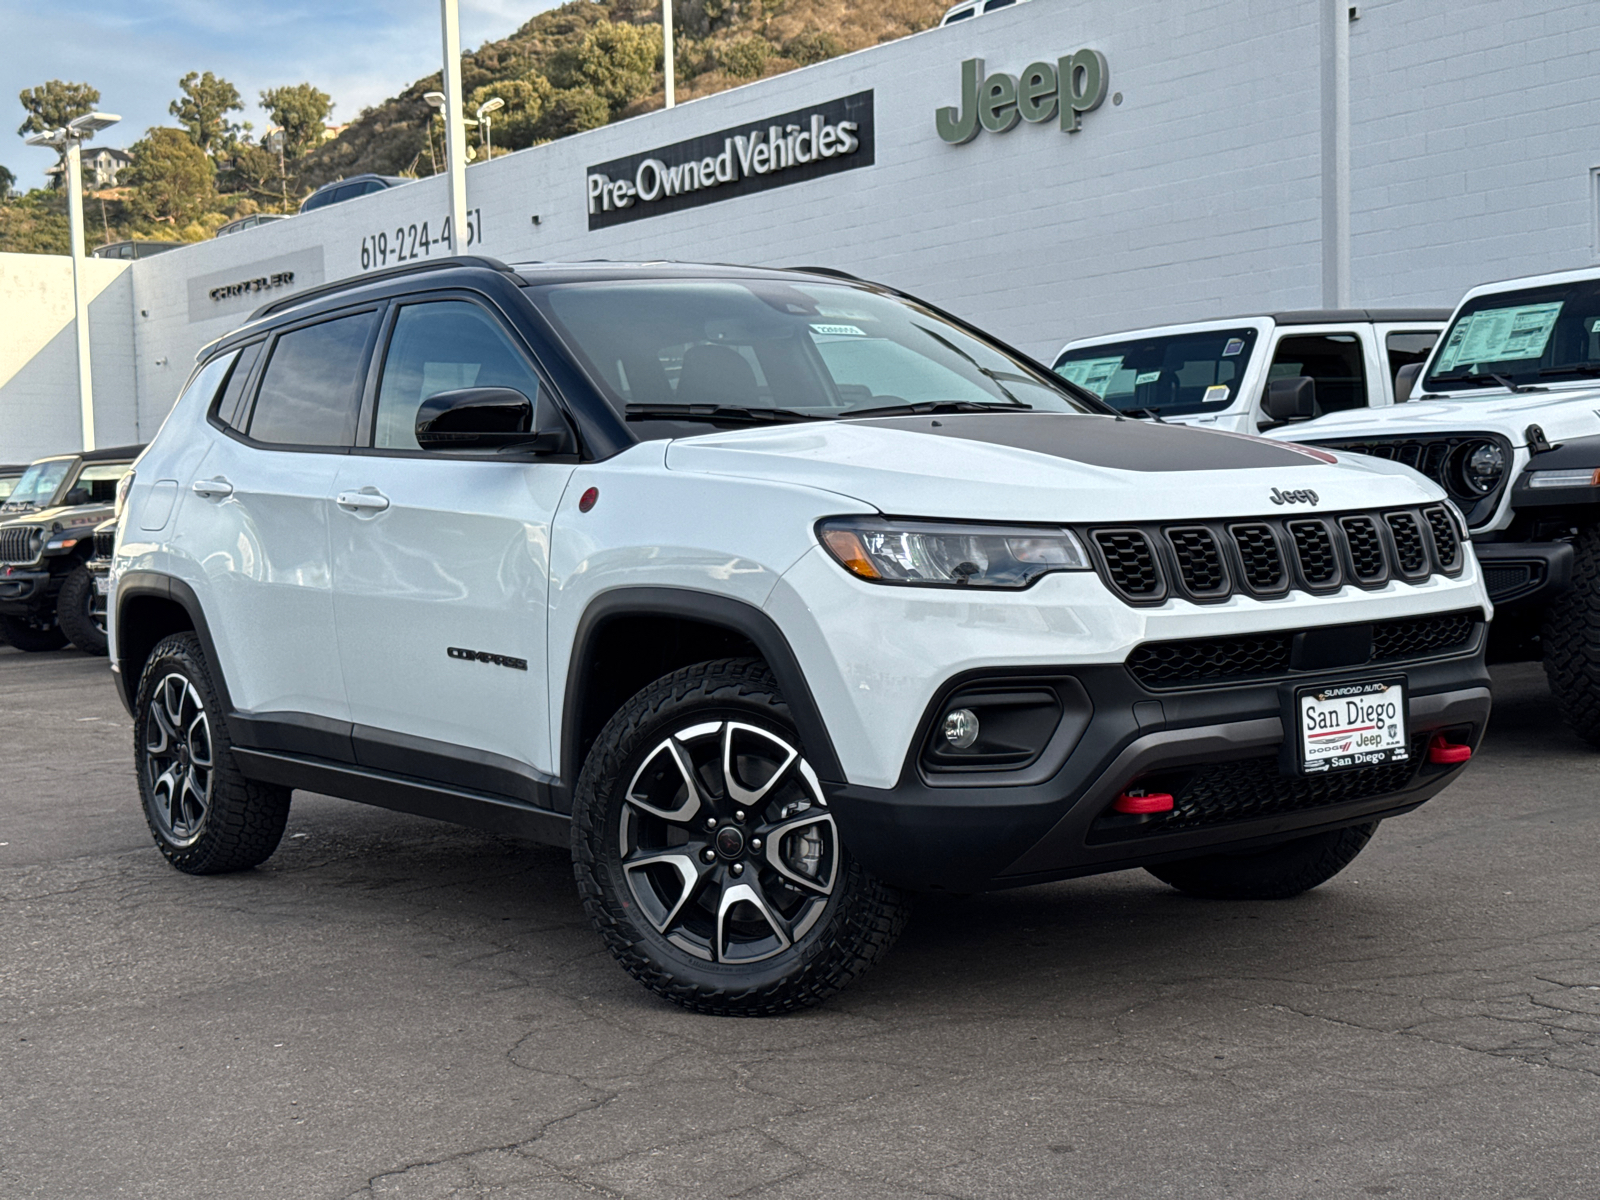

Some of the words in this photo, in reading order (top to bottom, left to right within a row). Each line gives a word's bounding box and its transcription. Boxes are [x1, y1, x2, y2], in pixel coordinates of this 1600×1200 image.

[935, 48, 1110, 145] Jeep
[588, 136, 738, 214] Pre-Owned
[734, 114, 859, 177] Vehicles
[361, 207, 482, 270] 619-224-451
[209, 271, 295, 302] CHRYSLER
[1269, 487, 1320, 507] Jeep
[446, 646, 529, 672] COMPASS
[1324, 686, 1362, 697] SUNROAD
[1363, 682, 1384, 693] AUTO
[1306, 706, 1340, 731] San
[1346, 698, 1396, 730] Diego
[1309, 744, 1345, 754] DODGE
[1356, 733, 1382, 748] Jeep
[1331, 757, 1352, 768] San
[1354, 751, 1385, 764] Diego
